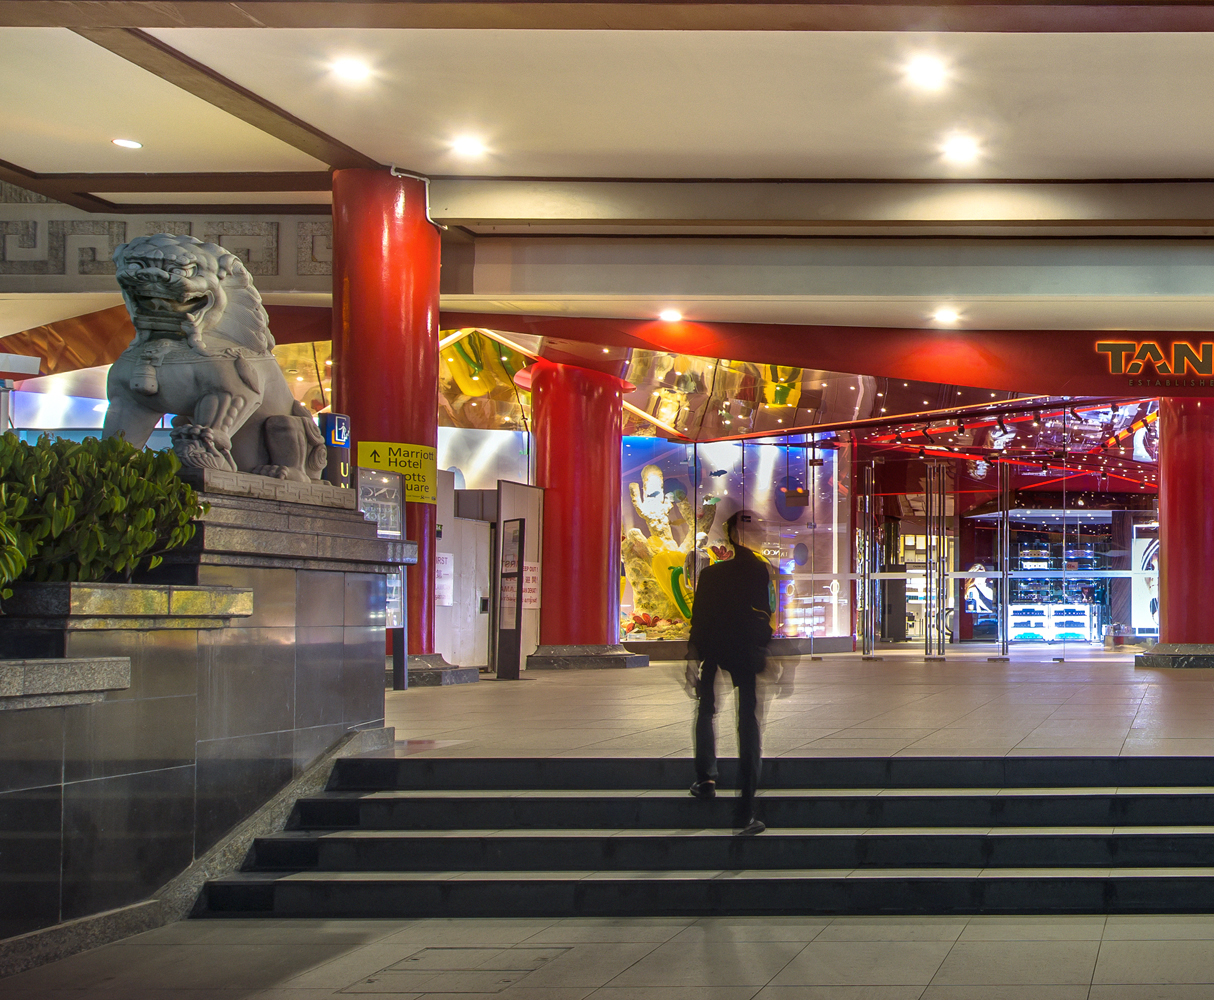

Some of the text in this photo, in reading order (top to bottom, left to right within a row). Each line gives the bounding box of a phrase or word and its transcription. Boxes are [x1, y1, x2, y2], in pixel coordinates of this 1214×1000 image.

[388, 447, 434, 461] Marriott
[388, 457, 422, 469] Hotel
[404, 472, 426, 483] otts
[406, 483, 430, 493] uare
